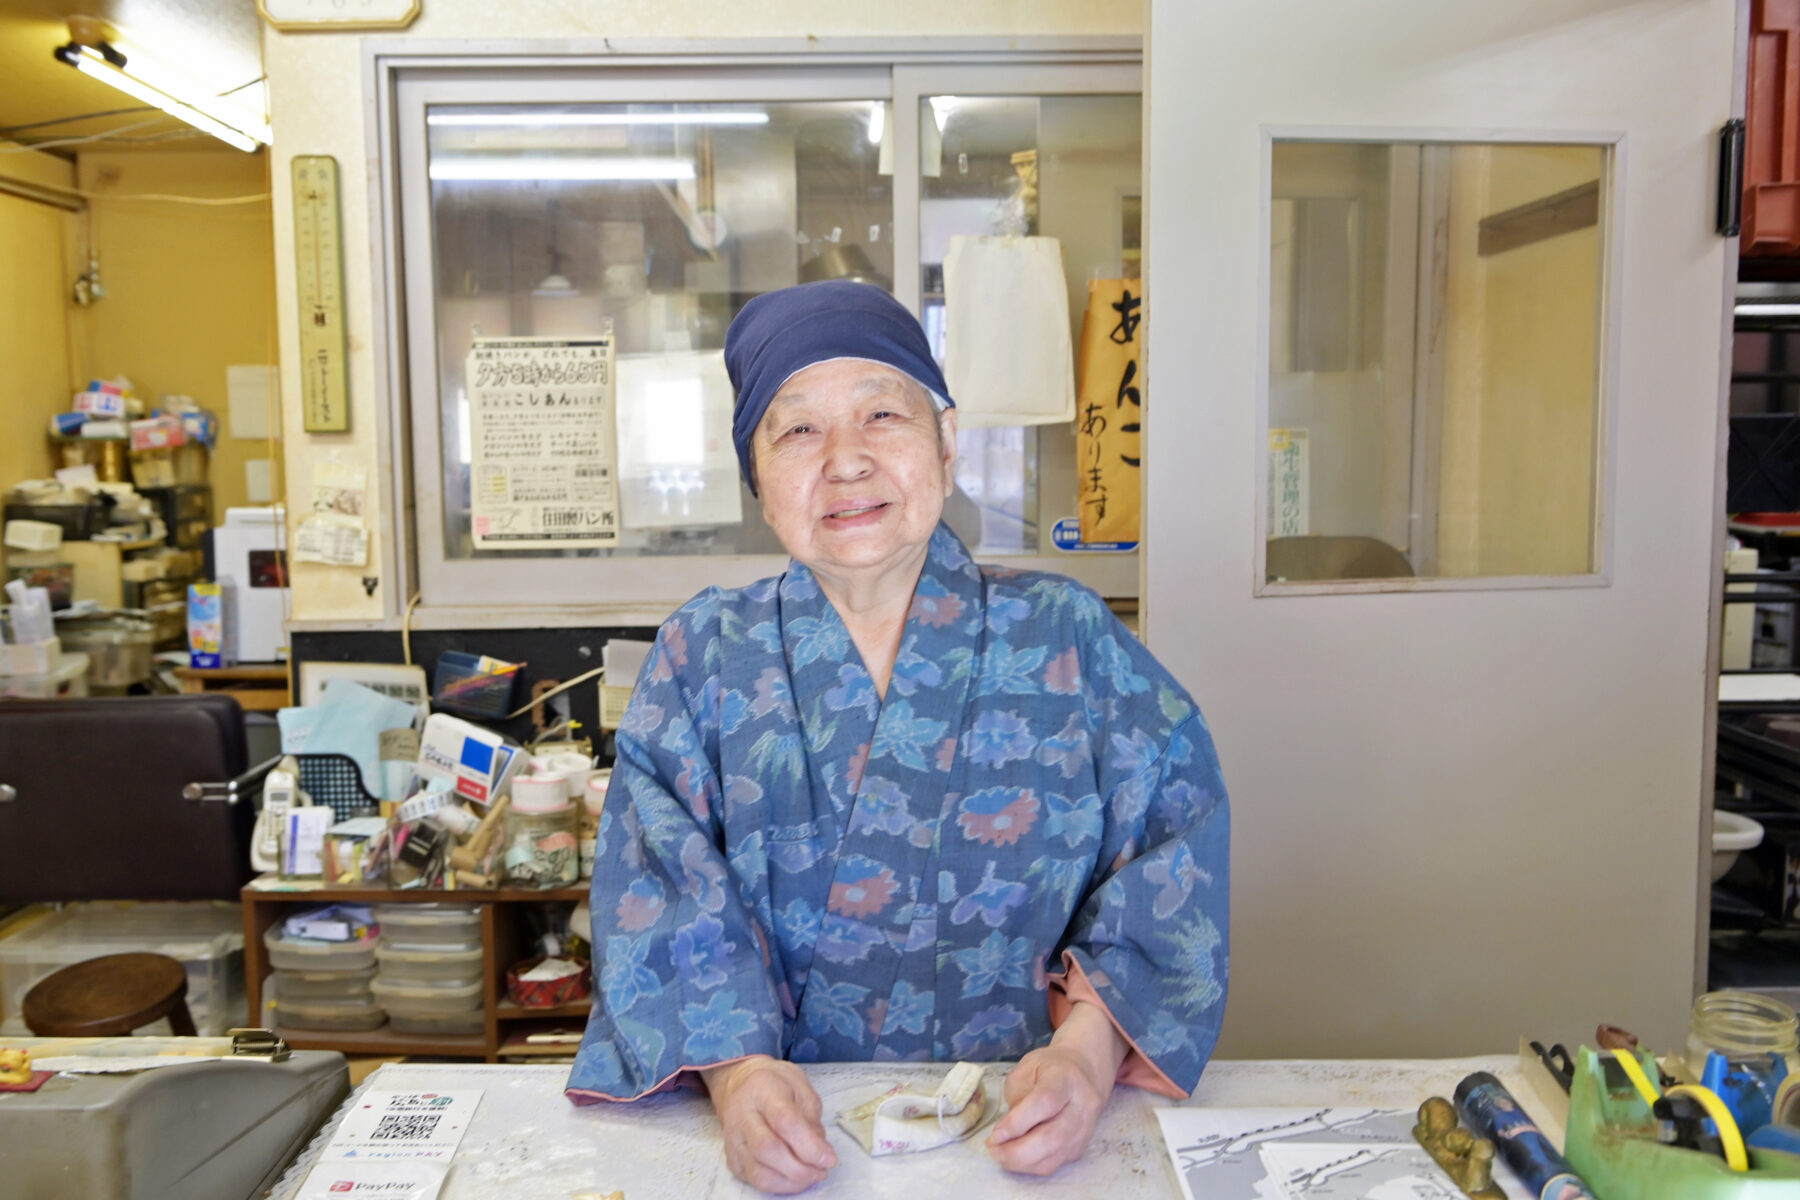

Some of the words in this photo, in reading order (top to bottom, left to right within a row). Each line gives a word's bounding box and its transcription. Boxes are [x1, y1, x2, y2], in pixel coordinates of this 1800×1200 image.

[475, 360, 608, 387] 夕方5時から65円
[514, 392, 571, 406] こしあん
[1079, 401, 1109, 526] あります
[543, 511, 614, 526] 住田製パン所
[355, 1181, 416, 1191] PayPay
